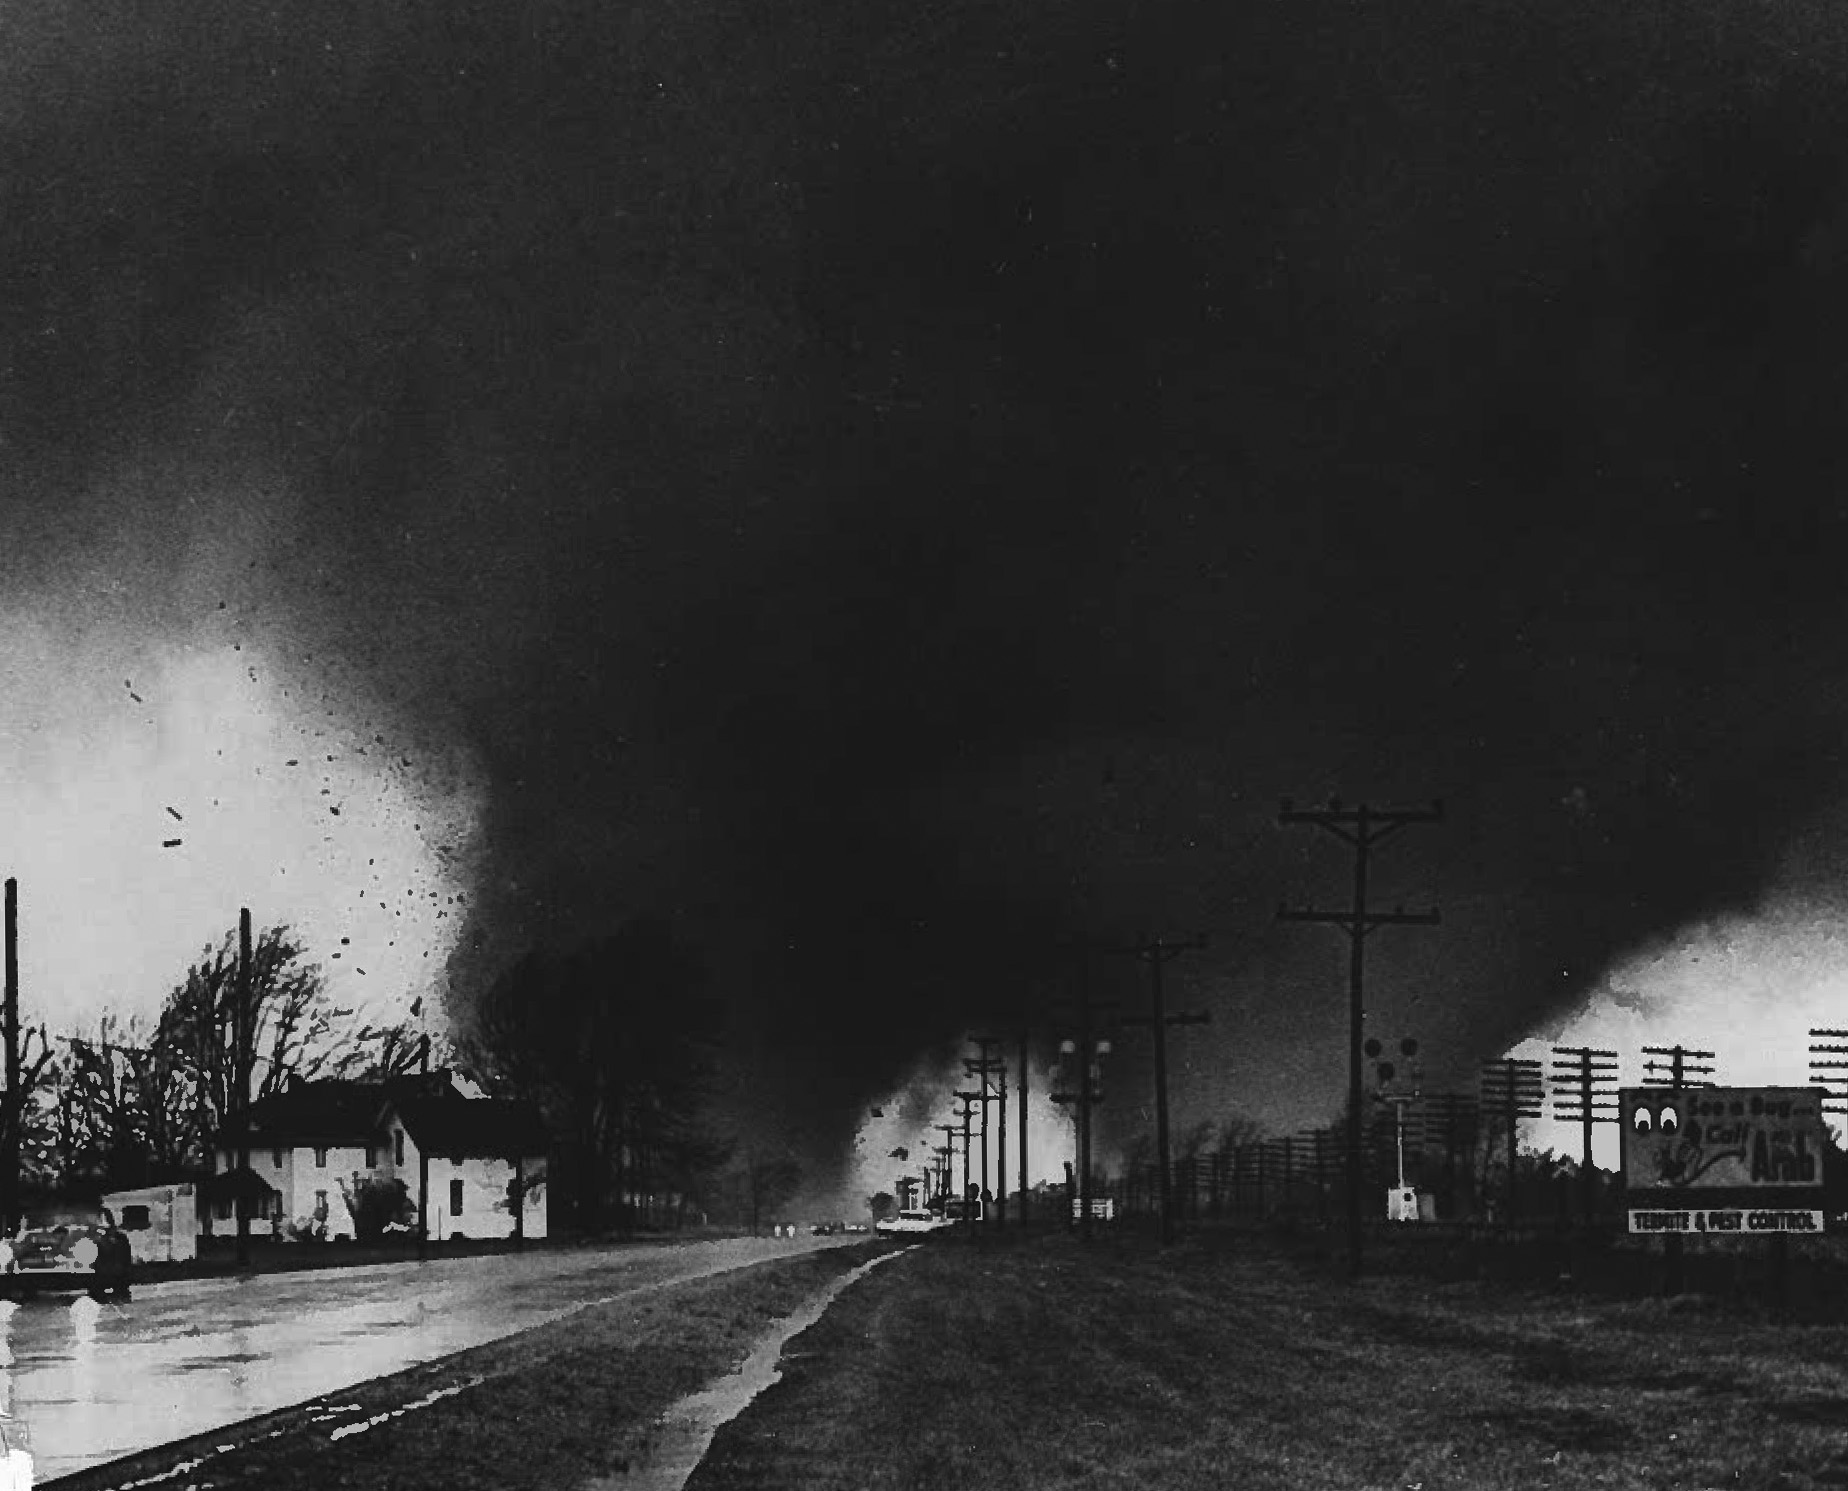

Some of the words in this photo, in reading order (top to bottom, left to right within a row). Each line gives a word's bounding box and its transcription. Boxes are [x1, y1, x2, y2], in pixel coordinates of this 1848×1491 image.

[1634, 1212, 1690, 1230] TERMITE
[1708, 1212, 1742, 1230] PEST
[1748, 1212, 1818, 1230] CONTROL
